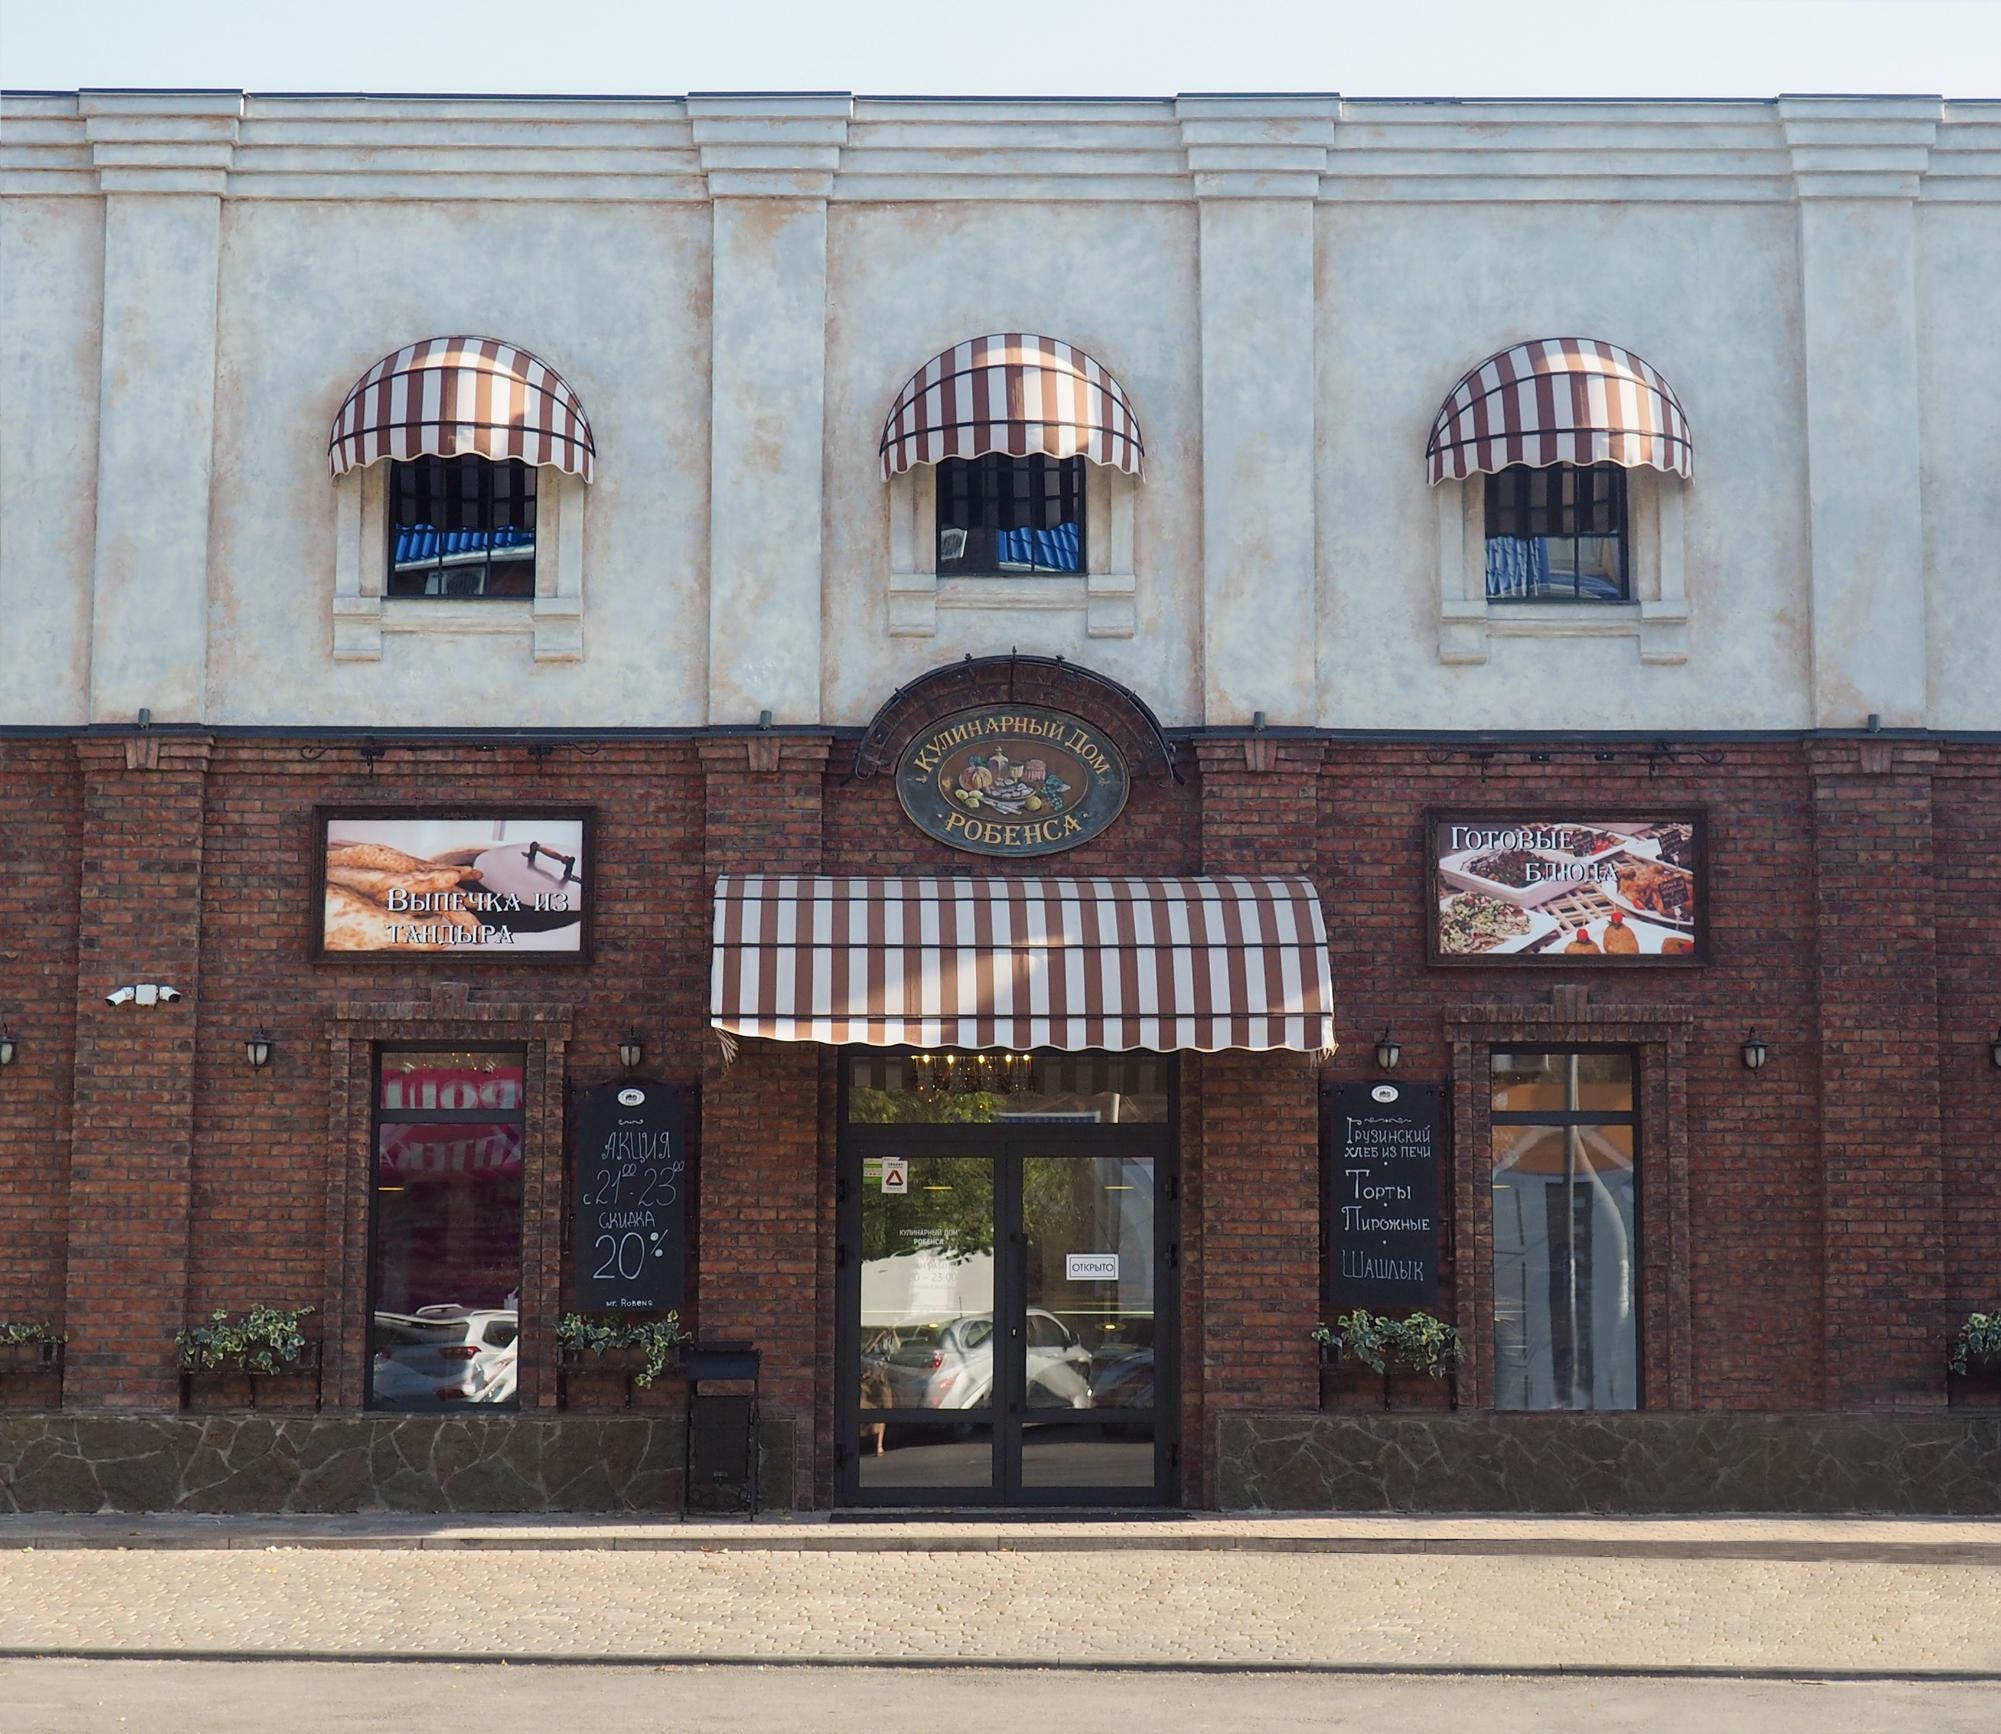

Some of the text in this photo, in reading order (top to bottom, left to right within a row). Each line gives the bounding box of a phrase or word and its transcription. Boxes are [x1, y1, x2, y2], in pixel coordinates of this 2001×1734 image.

[913, 716, 1111, 775] КУЛИНАРНЫЙ ДОМ
[945, 812, 1082, 846] РОБЕНСА
[1451, 826, 1575, 850] Готовые
[386, 888, 521, 912] Выпечка
[601, 1131, 671, 1163] АКЦИЯ
[1345, 1169, 1411, 1200] Торты
[1341, 1206, 1430, 1231] Пирожные
[593, 1229, 668, 1280] 20%
[1071, 1263, 1114, 1273] ОТКРЫТО
